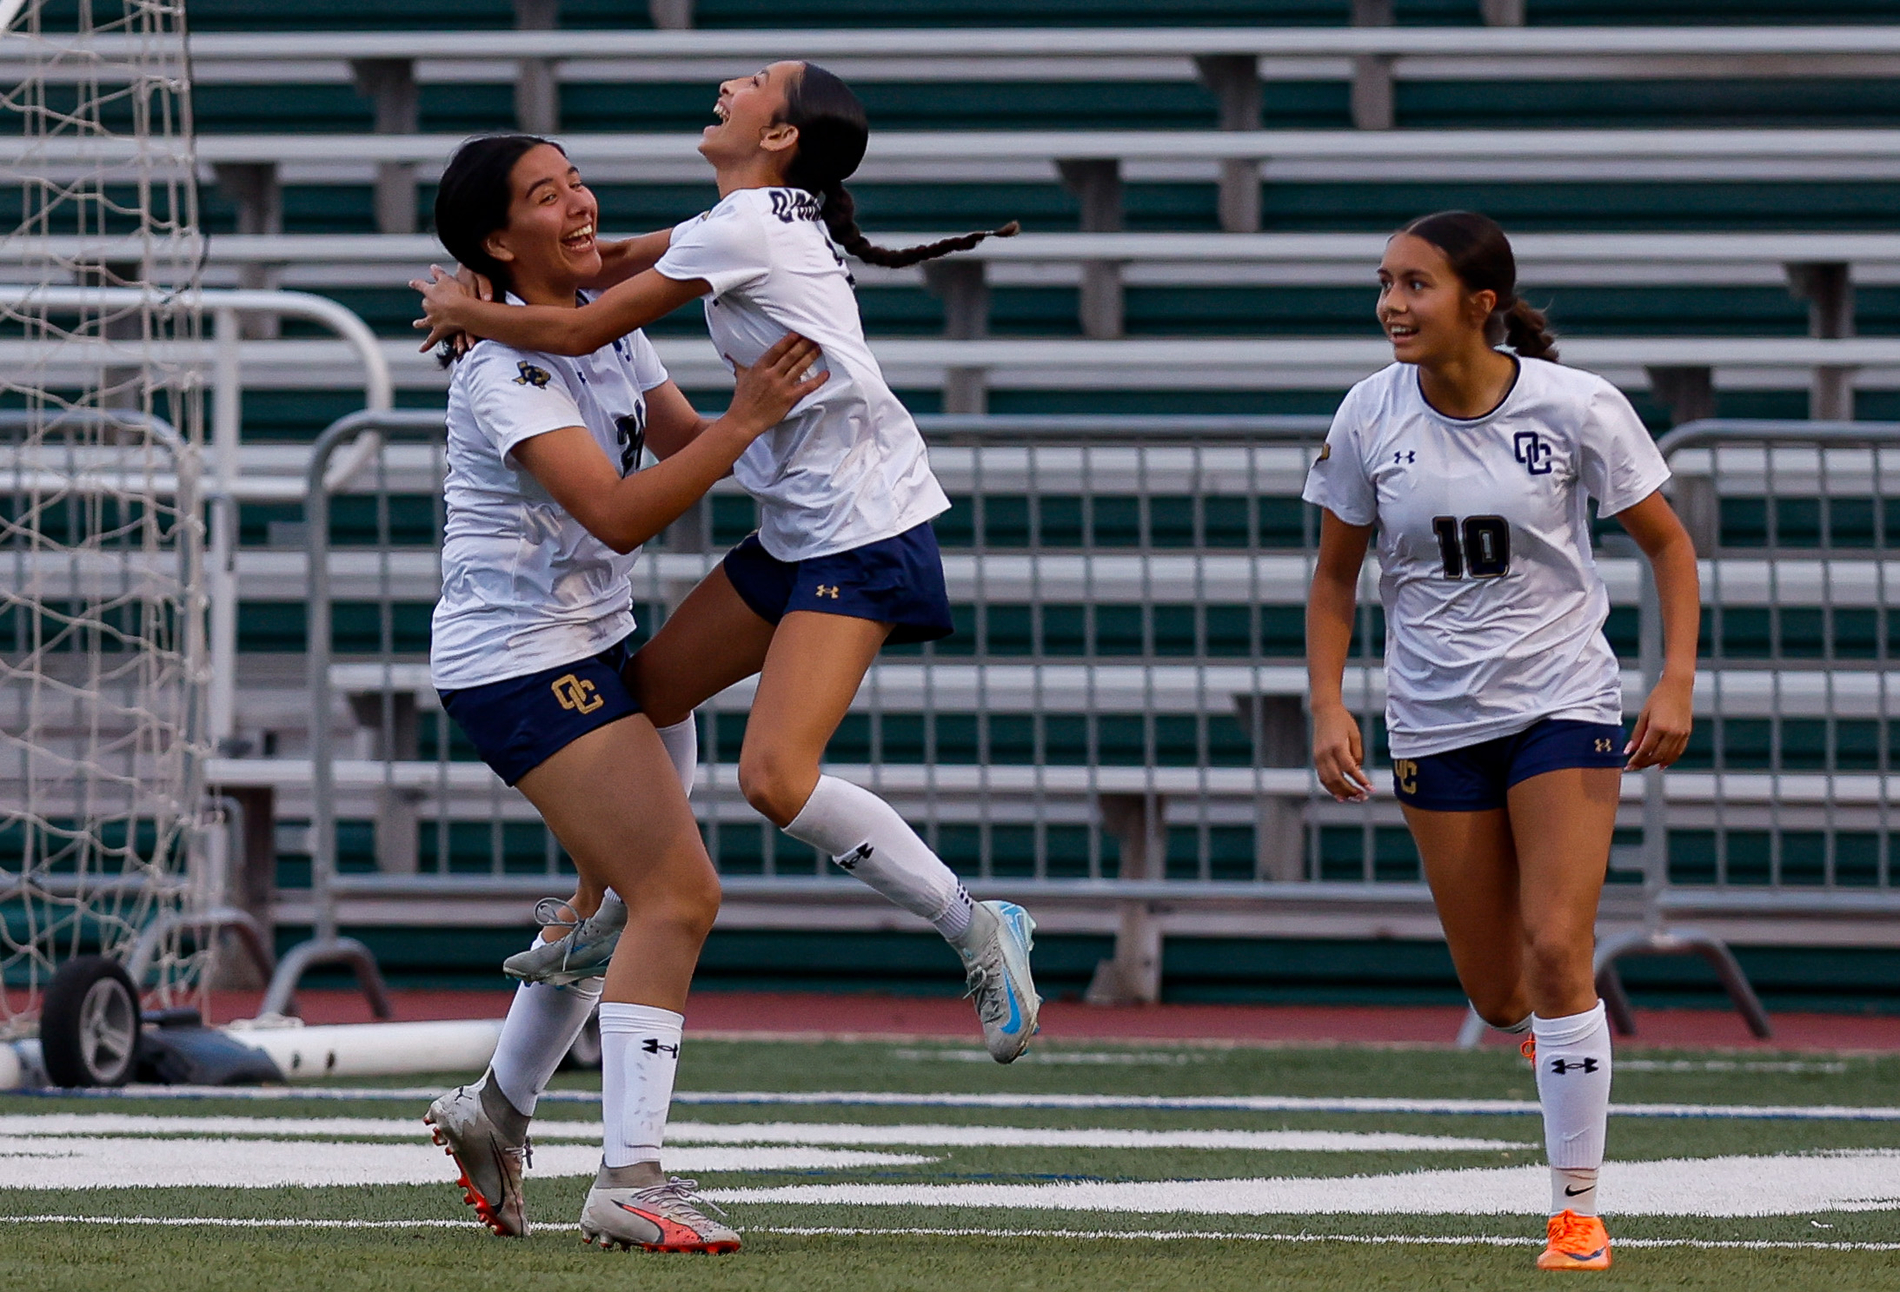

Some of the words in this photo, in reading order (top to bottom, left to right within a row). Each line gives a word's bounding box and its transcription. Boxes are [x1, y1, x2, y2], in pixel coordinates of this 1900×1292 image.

[1513, 431, 1552, 475] OC
[1432, 514, 1510, 580] 10
[551, 673, 604, 715] OC
